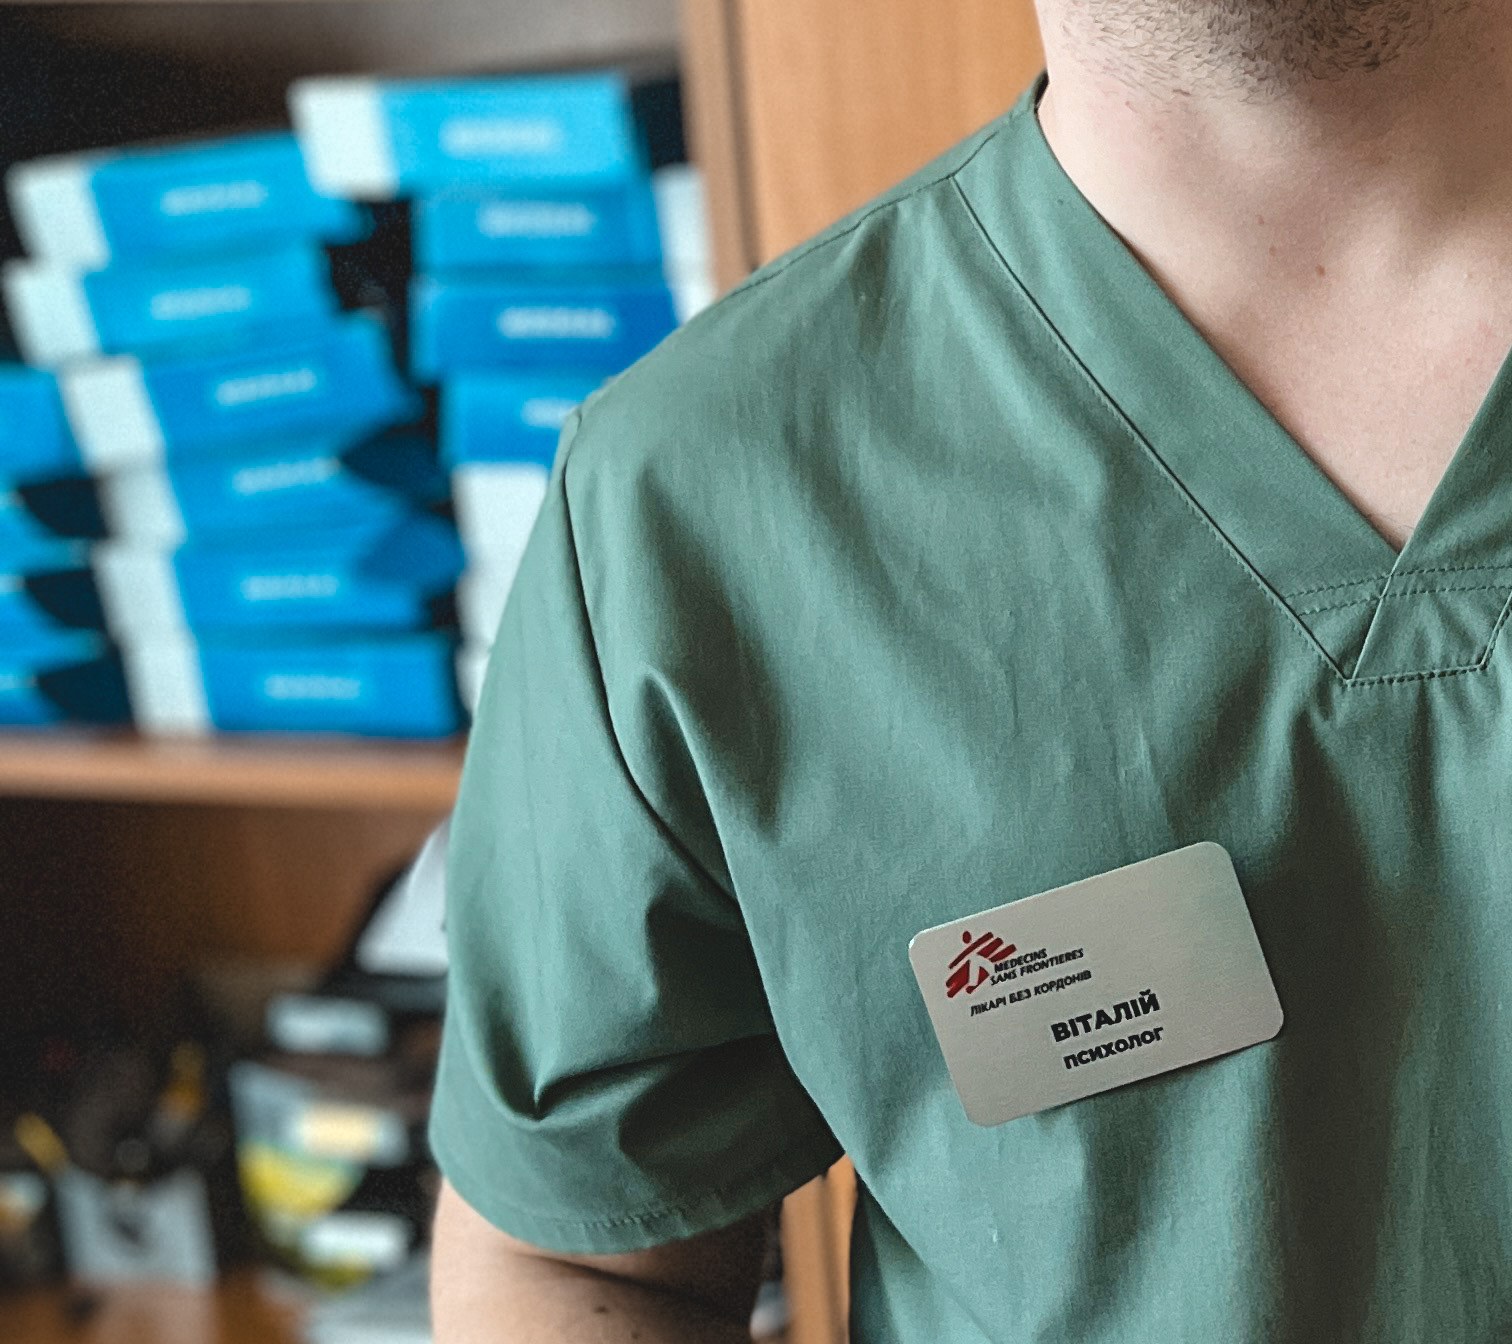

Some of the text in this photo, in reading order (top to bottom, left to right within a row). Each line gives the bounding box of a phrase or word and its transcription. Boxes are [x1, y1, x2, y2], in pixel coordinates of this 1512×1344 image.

[970, 970, 1092, 1017] ЛІКАРІ БЕЗ КОРДОНІВ
[990, 969, 1017, 986] SANS
[1051, 989, 1161, 1043] ВІТАЛІЙ
